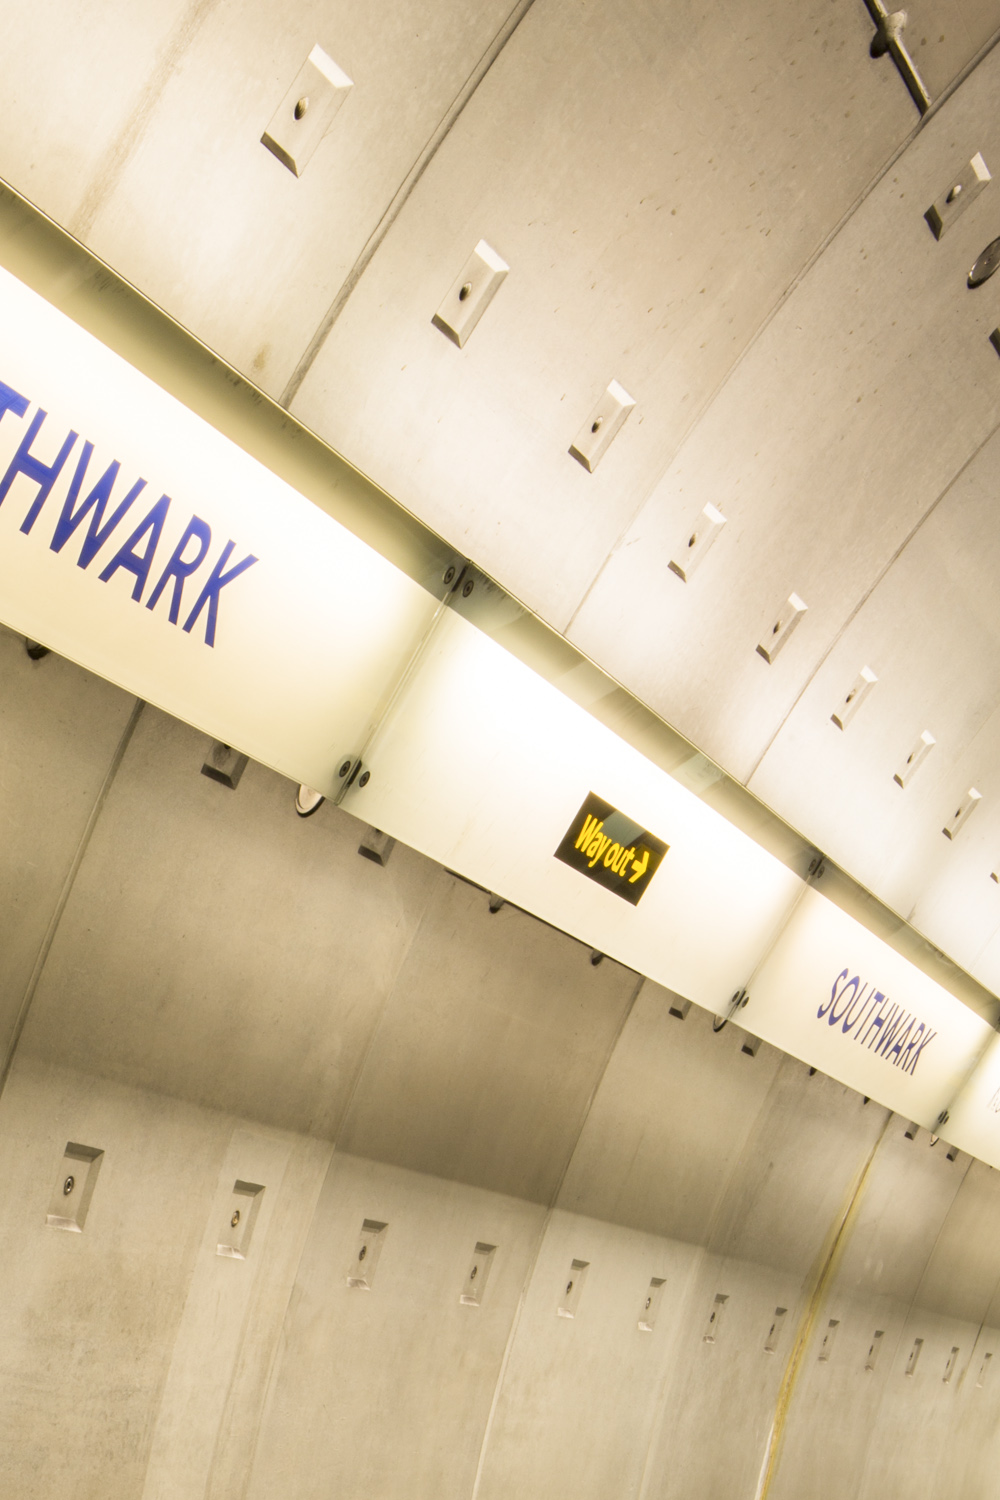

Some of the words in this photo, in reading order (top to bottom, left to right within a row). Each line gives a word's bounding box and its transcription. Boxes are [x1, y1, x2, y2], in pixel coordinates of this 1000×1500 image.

[574, 813, 613, 868] Way
[603, 842, 636, 877] out
[816, 967, 938, 1076] SOUTHWARK
